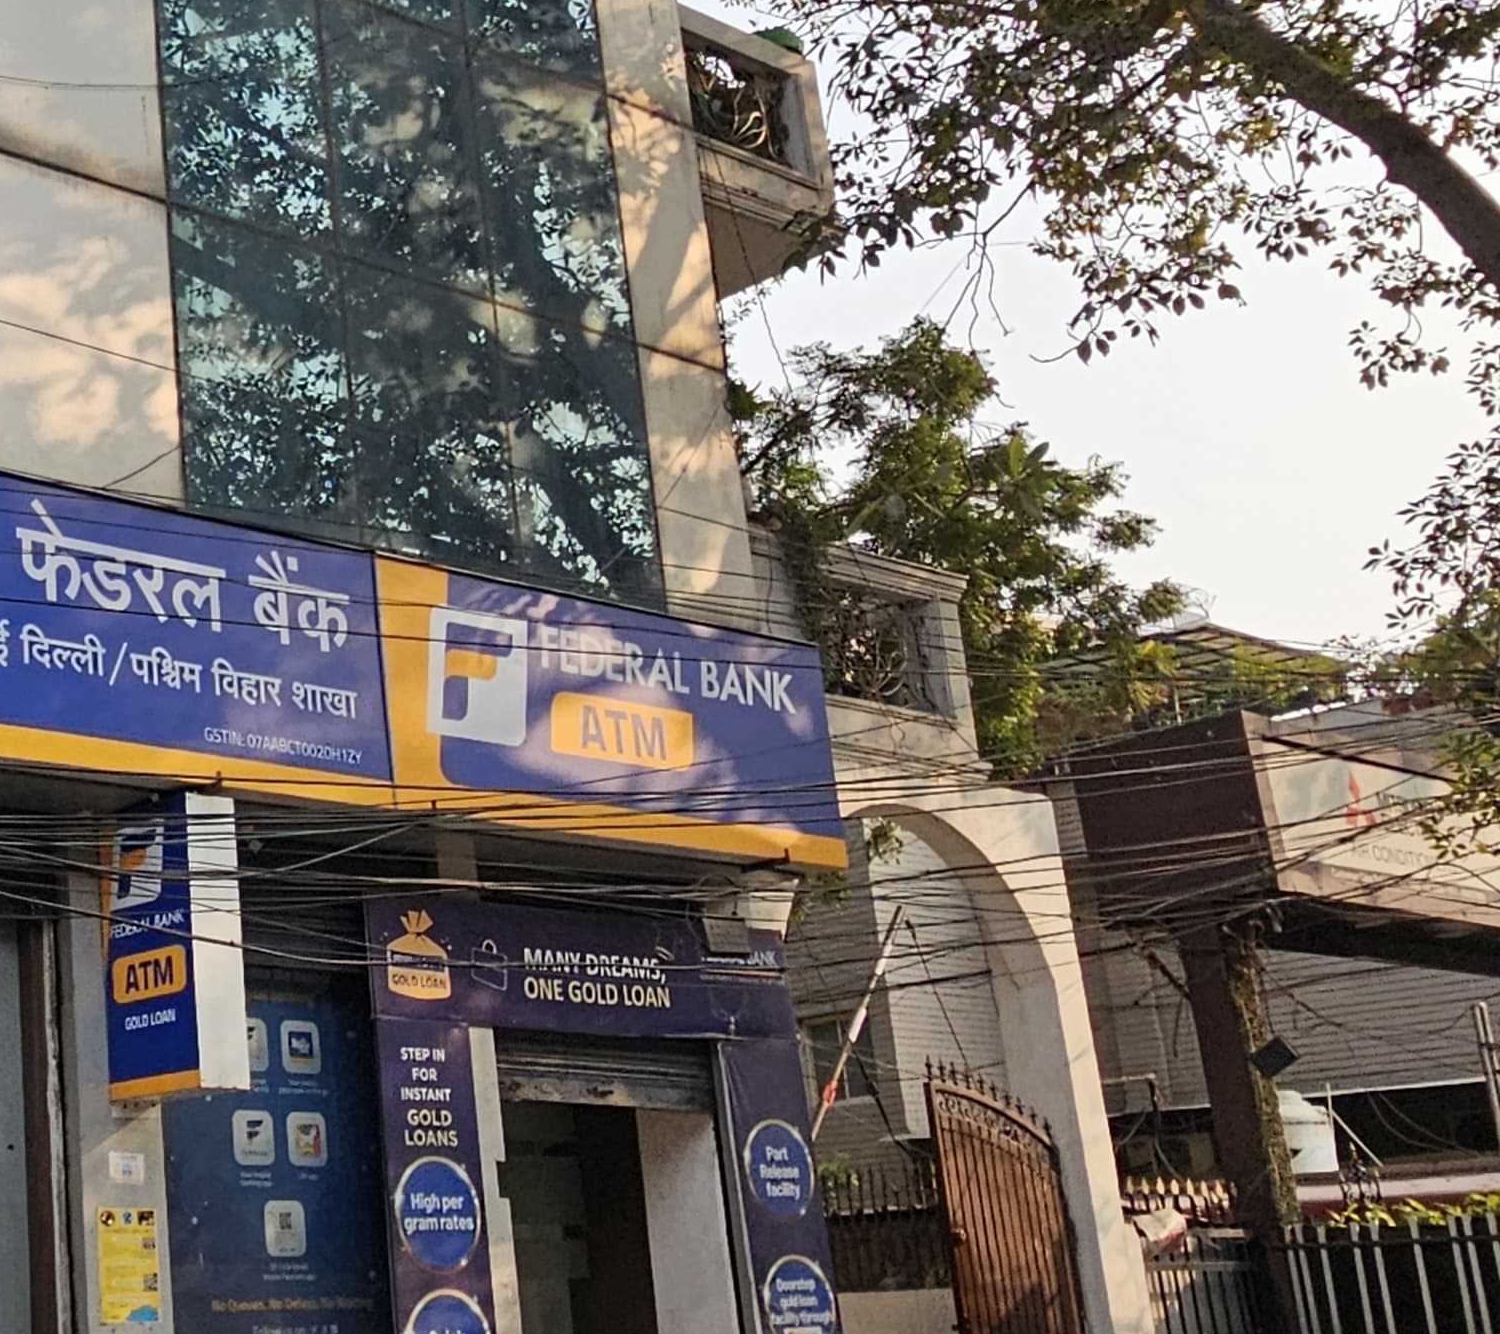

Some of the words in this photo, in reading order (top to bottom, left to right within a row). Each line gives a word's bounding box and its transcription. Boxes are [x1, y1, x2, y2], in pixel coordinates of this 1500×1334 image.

[15, 499, 227, 633] फेडरल
[248, 550, 350, 653] बैंक
[539, 623, 690, 696] FEDERAL
[701, 660, 796, 715] BANK
[210, 656, 282, 707] विहार
[291, 681, 358, 719] शाखा
[581, 703, 668, 761] ATM
[125, 955, 174, 995] ATM
[523, 947, 581, 974] MANY
[585, 953, 667, 985] DREAMS,
[391, 973, 419, 987] GOLD
[419, 975, 447, 989] LOAN
[523, 976, 565, 1002] ONE
[568, 980, 619, 1006] GOLD
[623, 984, 671, 1009] LOAN
[124, 1013, 149, 1031] GOLD
[150, 1008, 177, 1027] LOAN
[400, 1046, 430, 1062] STEP
[432, 1048, 446, 1063] IN
[411, 1067, 438, 1083] FOR
[400, 1087, 452, 1102] INSTANT
[406, 1109, 453, 1127] GOLD
[404, 1129, 459, 1148] LOANS
[765, 1145, 790, 1162] Part
[759, 1164, 801, 1180] Release
[765, 1181, 802, 1201] facility
[410, 1192, 441, 1216] High
[441, 1195, 465, 1215] per
[403, 1217, 440, 1235] gram
[440, 1215, 475, 1232] rates
[776, 1277, 817, 1295] Doorstep
